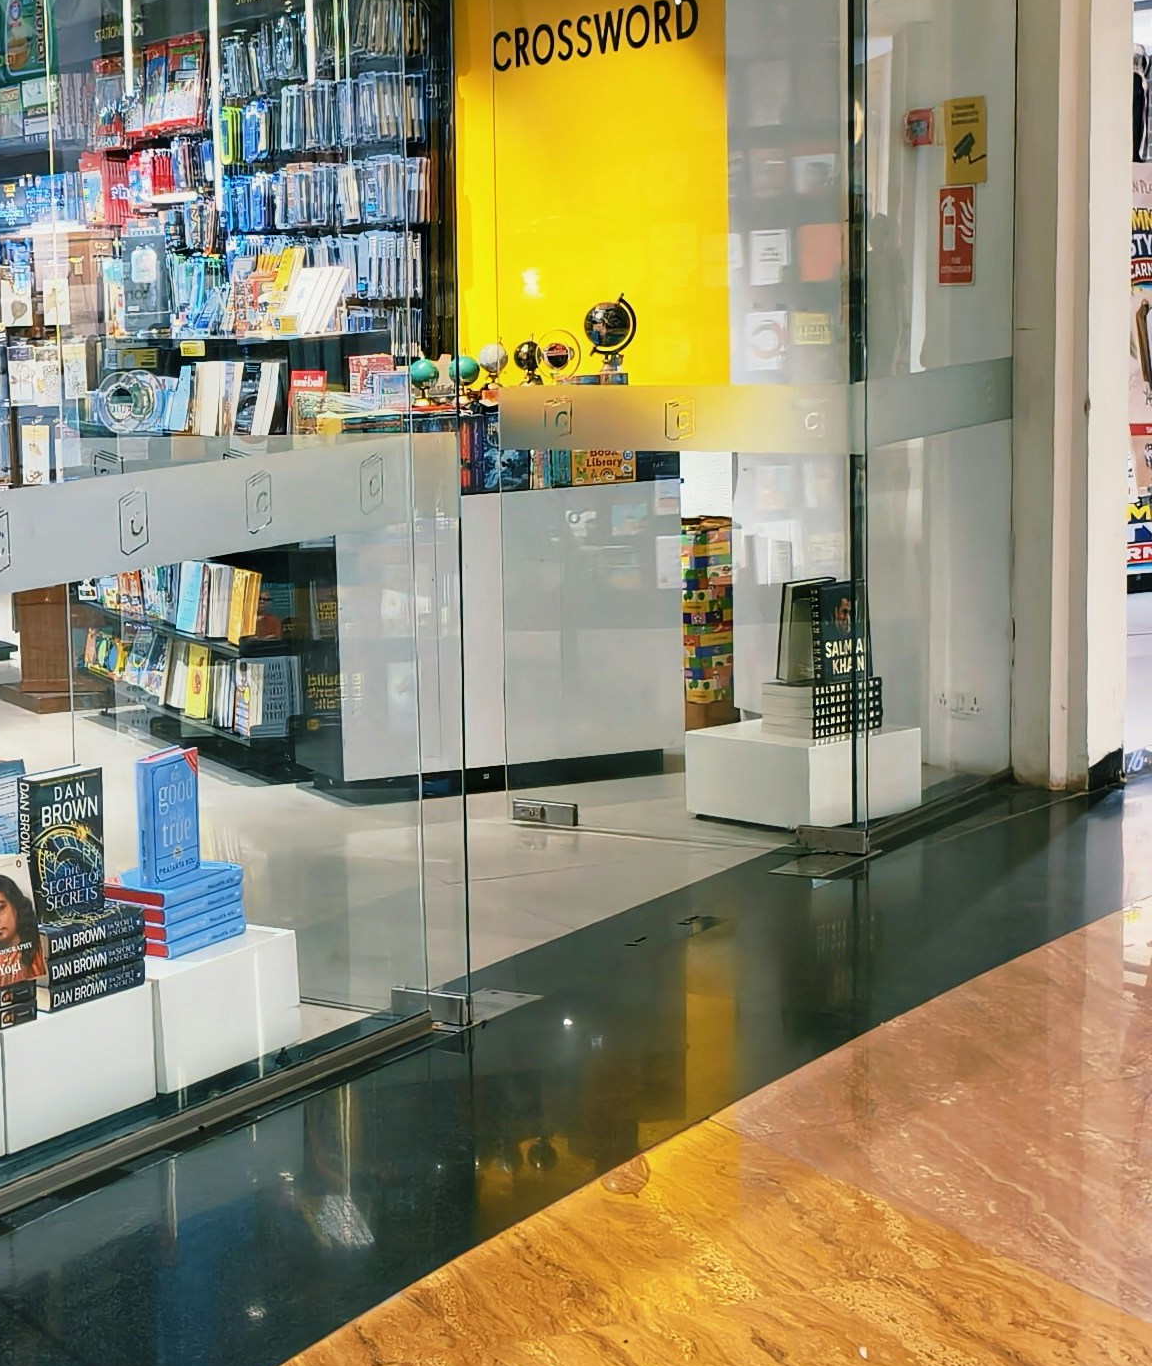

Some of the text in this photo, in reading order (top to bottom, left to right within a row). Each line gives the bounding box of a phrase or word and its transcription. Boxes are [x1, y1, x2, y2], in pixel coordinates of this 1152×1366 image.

[586, 457, 623, 468] Library
[19, 782, 30, 810] DAN
[54, 781, 85, 802] DAN
[158, 773, 193, 815] good
[41, 795, 98, 828] BROWN
[162, 817, 192, 848] true
[41, 872, 86, 897] SECRET
[46, 887, 98, 912] SECRETS
[51, 924, 107, 954] DAN BROWN
[52, 951, 107, 980] DAN BROWN
[53, 979, 107, 1008] DAN BROWN
